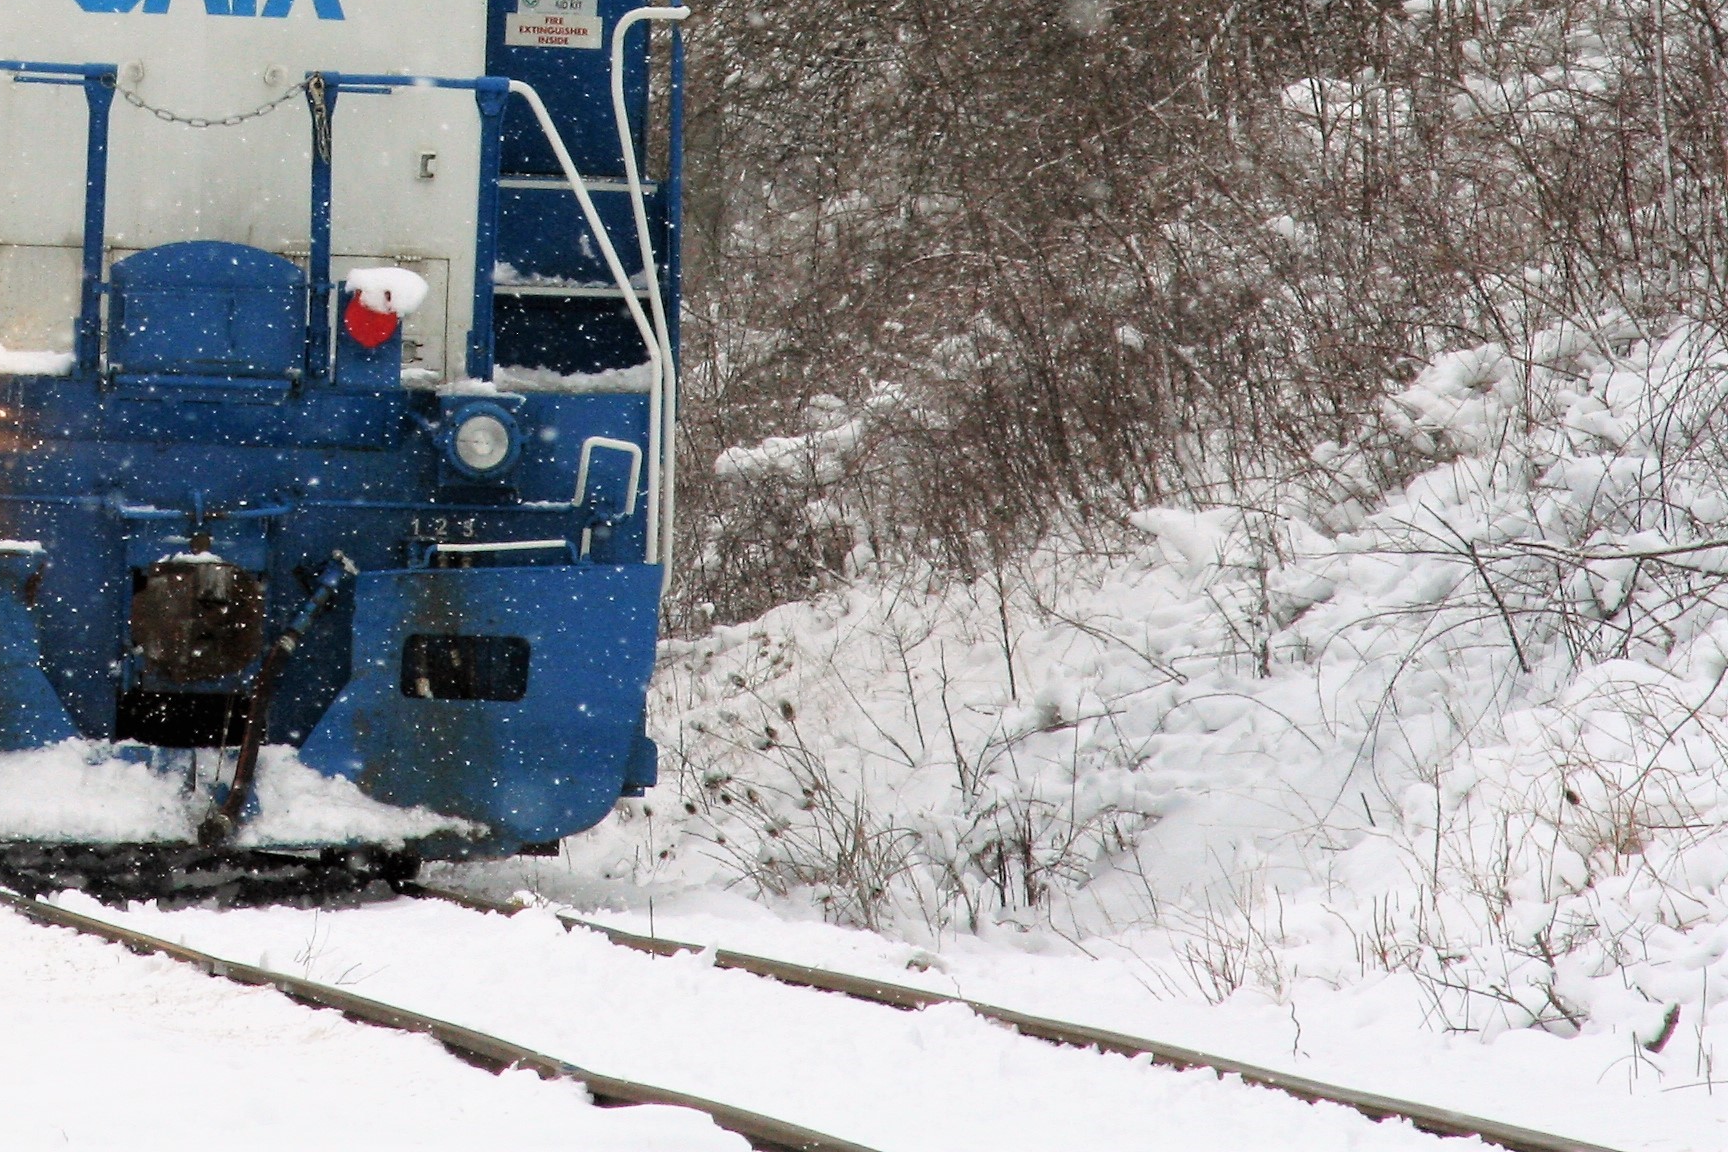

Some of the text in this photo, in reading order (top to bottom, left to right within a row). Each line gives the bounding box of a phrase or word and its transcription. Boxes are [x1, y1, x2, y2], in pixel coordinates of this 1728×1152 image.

[545, 16, 564, 25] FIRE
[519, 25, 588, 36] EXTINGUISHER
[538, 35, 569, 45] INSIDE
[435, 518, 447, 535] 2
